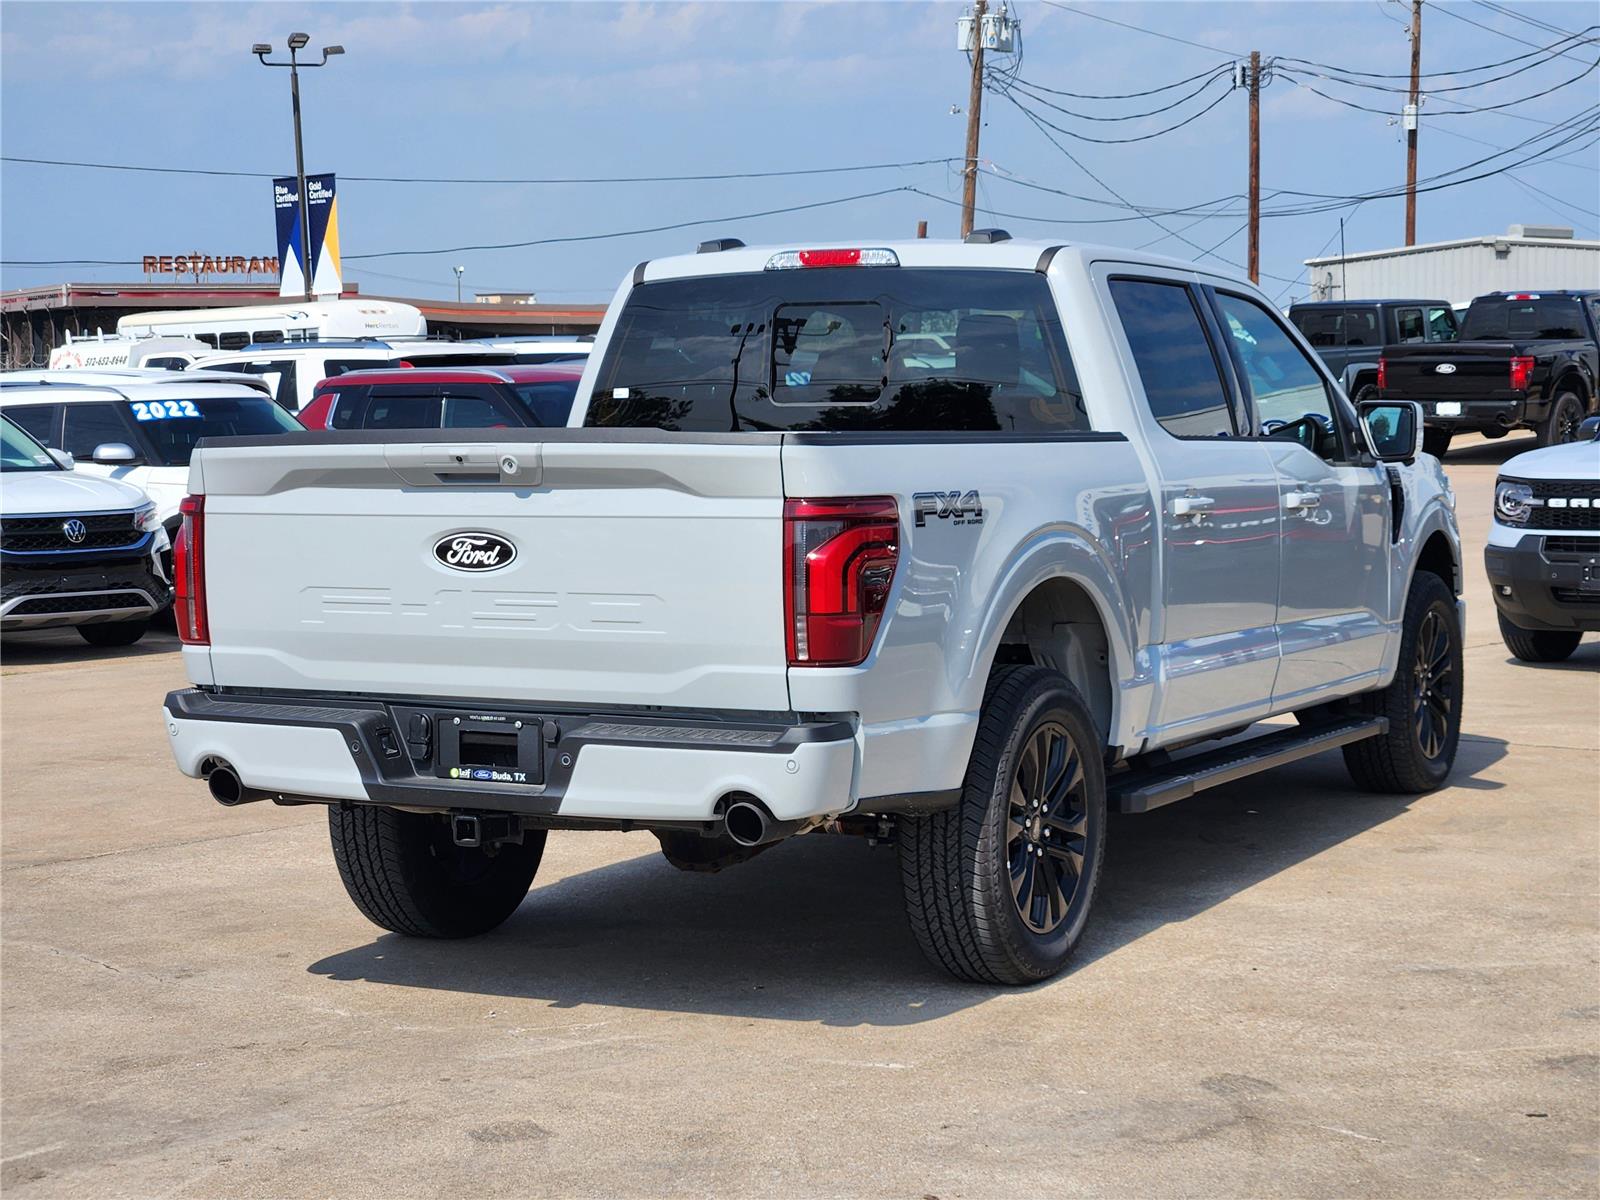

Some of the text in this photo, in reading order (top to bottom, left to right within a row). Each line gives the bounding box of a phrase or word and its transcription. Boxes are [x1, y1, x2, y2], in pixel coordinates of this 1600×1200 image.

[275, 186, 288, 194] Blue
[308, 181, 322, 190] Gold
[276, 193, 298, 203] Certified
[309, 189, 333, 199] Certified
[132, 400, 201, 420] 2022
[912, 490, 983, 528] FX4
[446, 537, 501, 565] Ford
[492, 771, 513, 782] Buda,
[513, 772, 526, 782] TX
